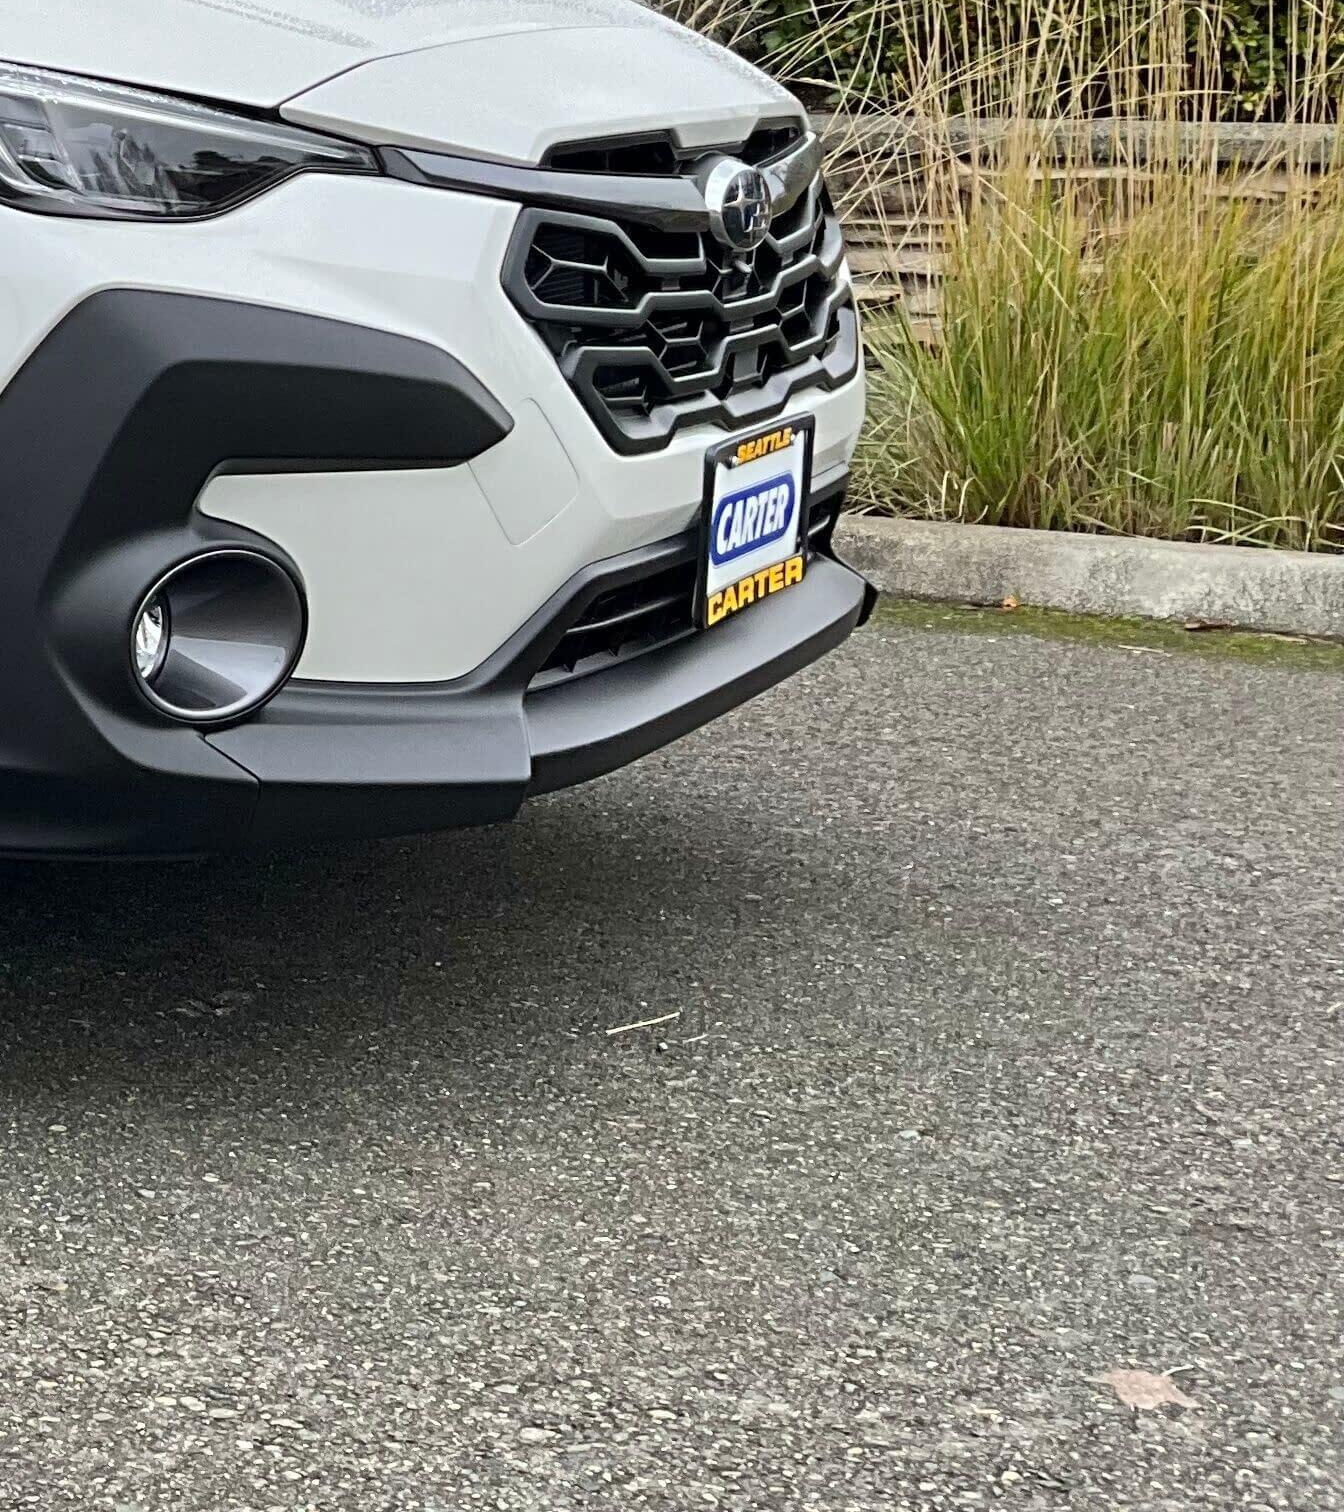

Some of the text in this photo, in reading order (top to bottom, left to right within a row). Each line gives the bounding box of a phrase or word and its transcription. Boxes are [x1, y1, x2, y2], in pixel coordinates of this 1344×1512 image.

[737, 427, 792, 465] SEATTLE
[715, 484, 790, 555] CARTER
[707, 556, 803, 626] CARTER
